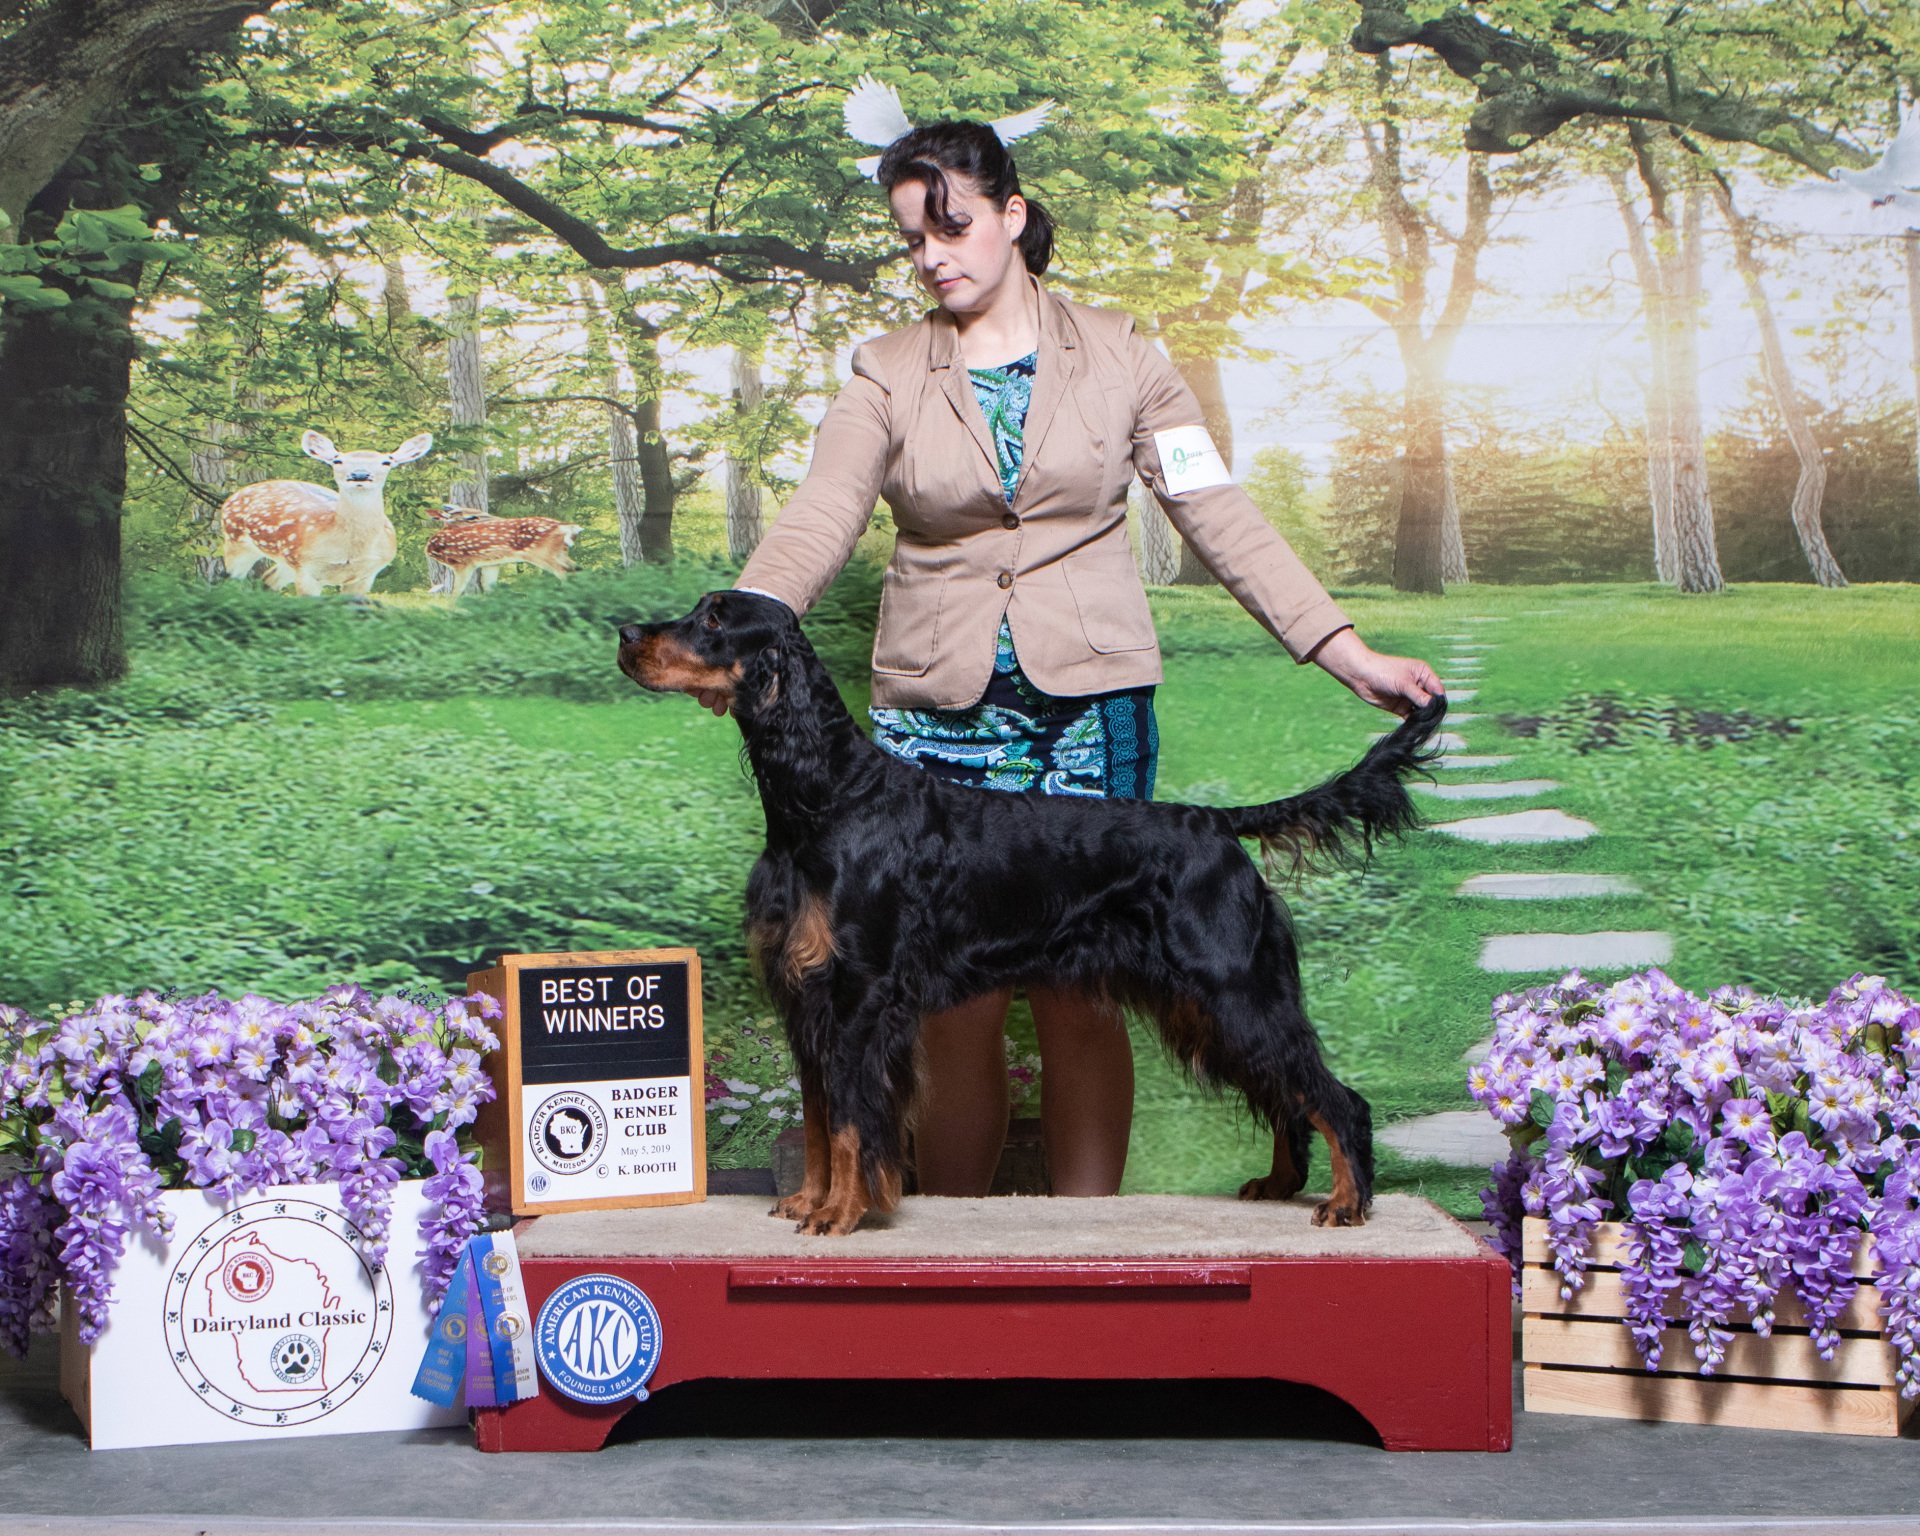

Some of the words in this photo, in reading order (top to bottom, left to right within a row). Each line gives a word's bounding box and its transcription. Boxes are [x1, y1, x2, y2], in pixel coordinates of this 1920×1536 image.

[542, 977, 613, 1004] BEST
[627, 976, 661, 1000] OF
[543, 1005, 665, 1034] WINNERS
[611, 1085, 678, 1101] BADGER
[614, 1104, 677, 1119] KENNEL
[534, 1111, 547, 1154] BADGER
[546, 1096, 586, 1110] KENNEL
[587, 1105, 603, 1129] CLUB
[560, 1125, 577, 1135] BKC
[624, 1123, 667, 1137] CLUB
[621, 1147, 639, 1157] May
[641, 1146, 649, 1155] 5,
[651, 1144, 671, 1154] 2019
[552, 1158, 587, 1169] MADISON
[618, 1165, 630, 1176] K.
[633, 1162, 677, 1175] BOOTH
[192, 1313, 291, 1335] Dairyland
[298, 1309, 367, 1327] Classic
[545, 1286, 591, 1345] AMERICAN
[593, 1285, 641, 1316] KENNEL
[637, 1315, 652, 1352] CLUB
[562, 1303, 631, 1378] AKC
[558, 1370, 606, 1394] FOUNDED
[610, 1376, 632, 1392] 1884
